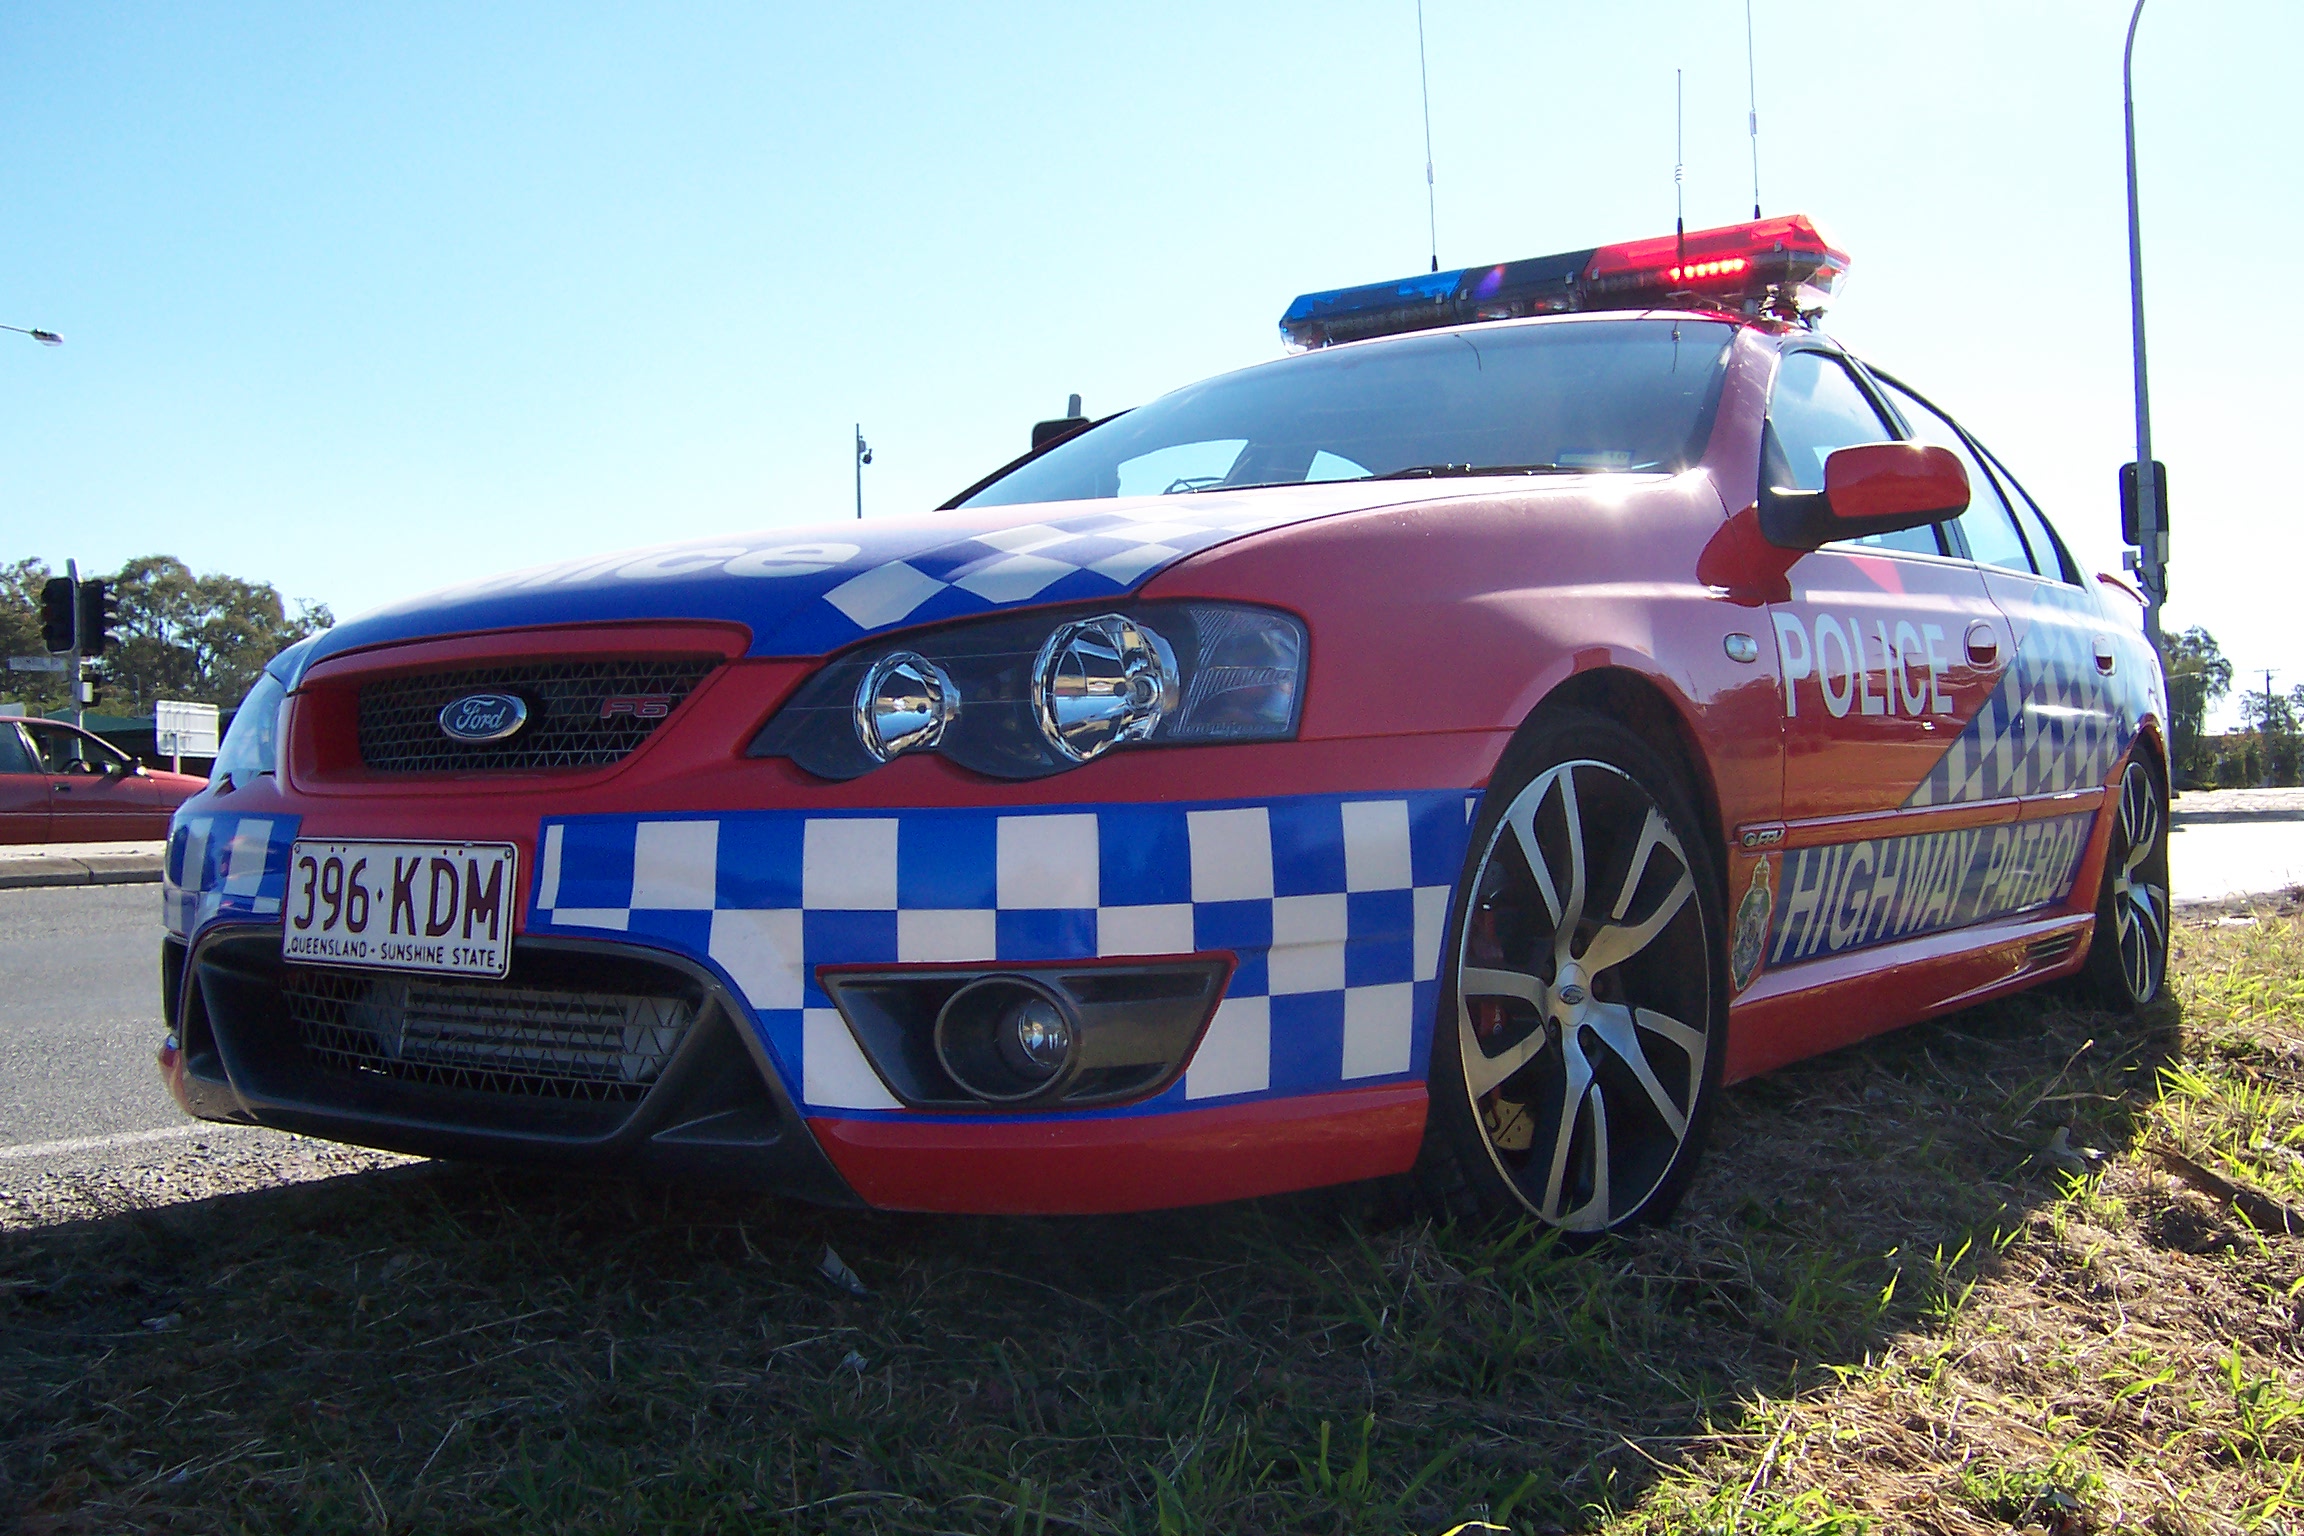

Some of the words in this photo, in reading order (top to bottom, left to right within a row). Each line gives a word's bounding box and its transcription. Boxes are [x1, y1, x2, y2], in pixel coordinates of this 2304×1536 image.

[1771, 610, 1954, 719] POLICE
[456, 699, 505, 731] Ford
[1770, 827, 1980, 963] HIGHWAY
[1972, 818, 2084, 919] PATROL
[290, 937, 367, 959] QUEENSLAND
[380, 942, 444, 965] SUNSHINE
[452, 948, 497, 968] STATE
